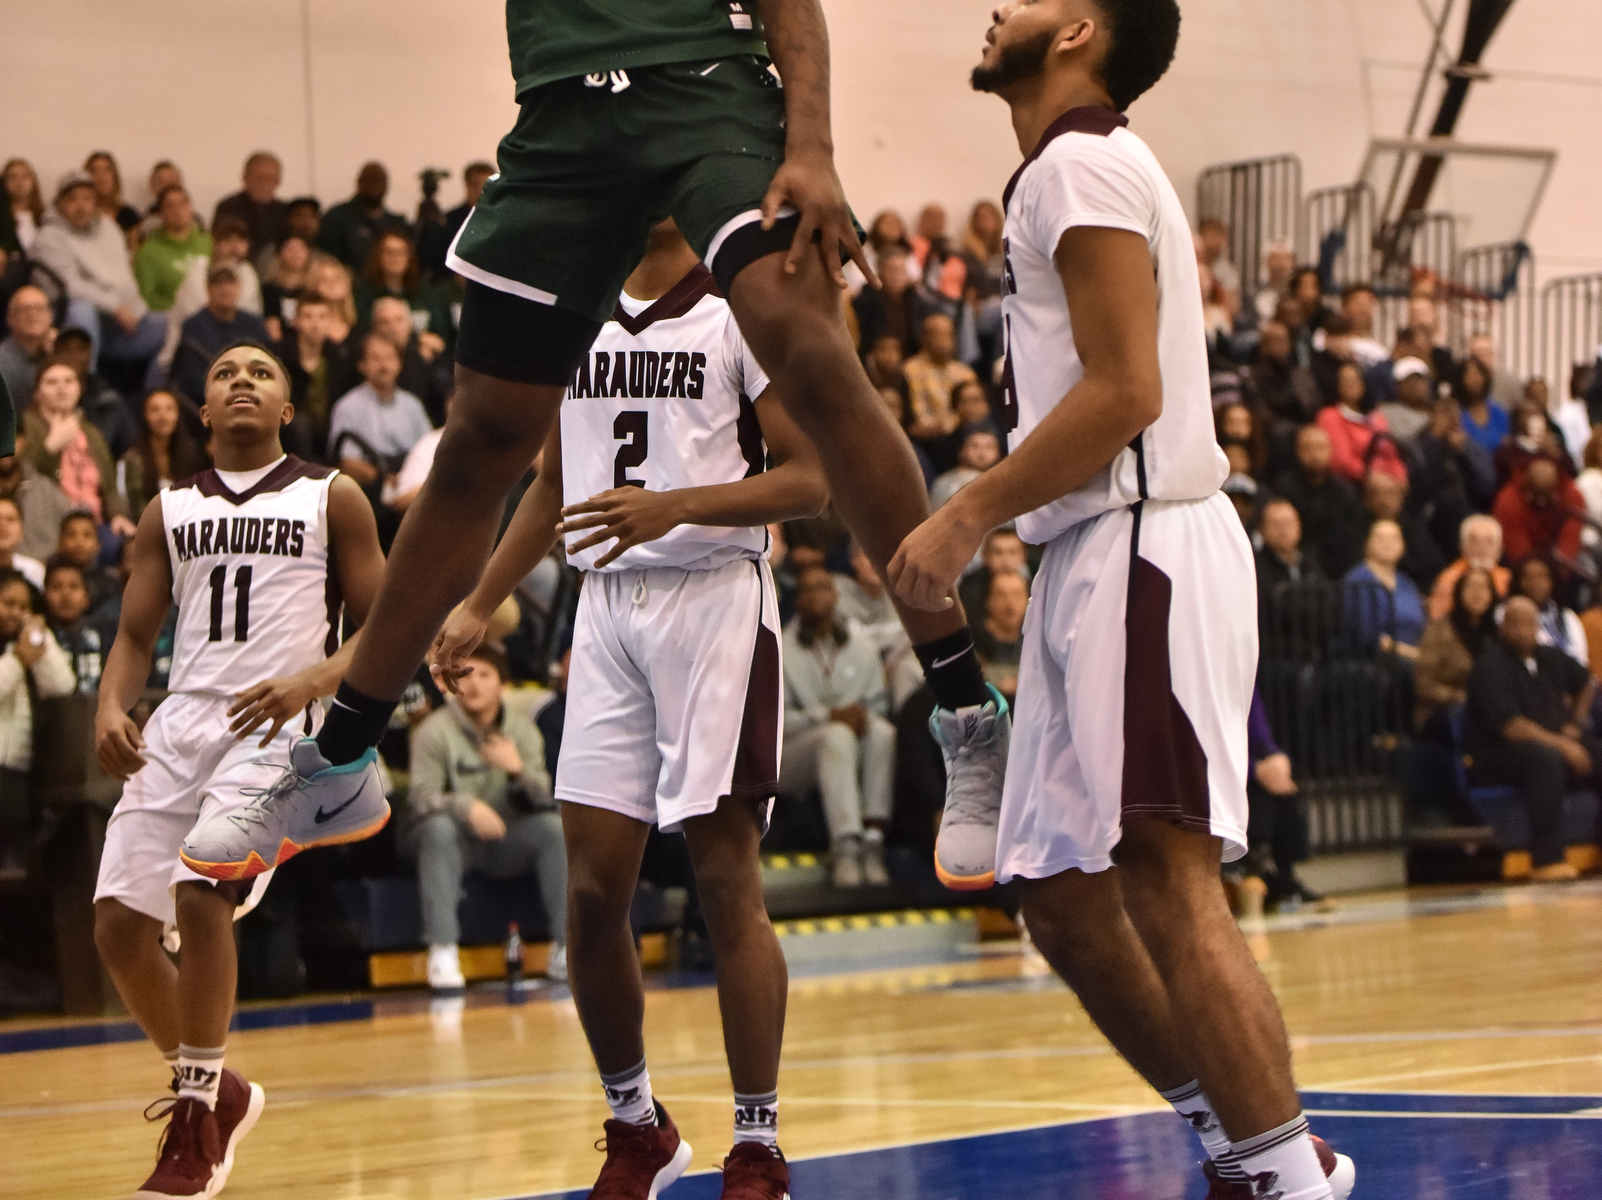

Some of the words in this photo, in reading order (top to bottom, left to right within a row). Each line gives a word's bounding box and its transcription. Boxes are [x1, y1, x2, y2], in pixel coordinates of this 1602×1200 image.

[613, 411, 648, 489] 2
[172, 517, 305, 562] MARAUDERS
[209, 565, 253, 642] 11
